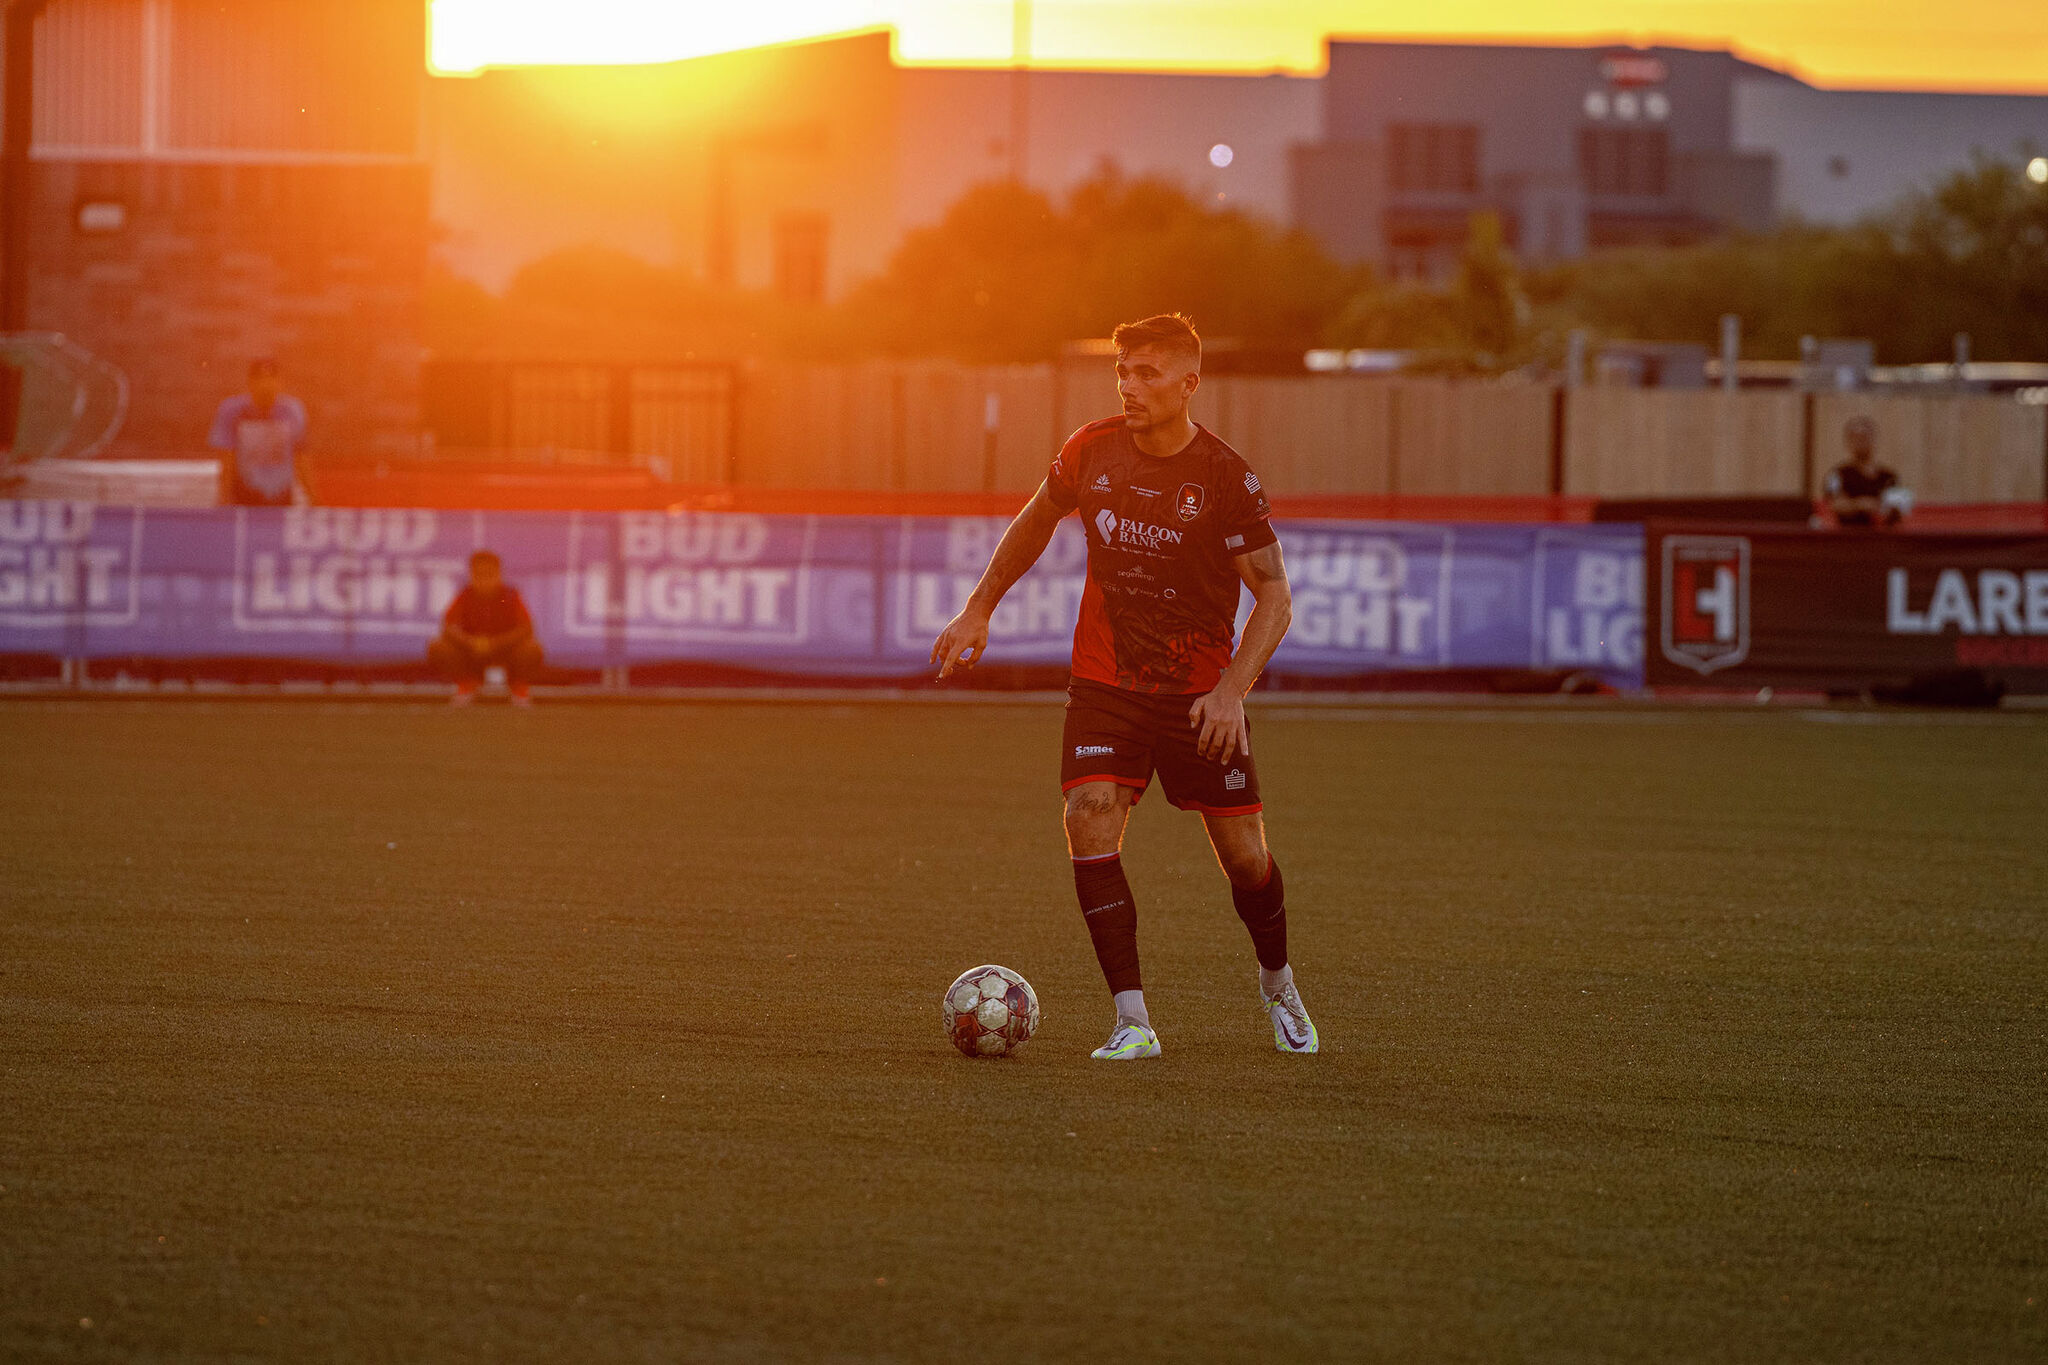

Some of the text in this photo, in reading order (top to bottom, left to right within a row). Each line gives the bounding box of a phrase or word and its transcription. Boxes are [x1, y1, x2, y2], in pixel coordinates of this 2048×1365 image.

[284, 508, 437, 550] BUD
[619, 511, 767, 561] BUD
[949, 517, 1087, 575] BD
[1120, 530, 1161, 551] BANK
[1121, 518, 1183, 545] FALCON
[252, 554, 465, 614] LIGHT
[583, 561, 788, 625] LIGHT
[1290, 590, 1432, 653] GHT
